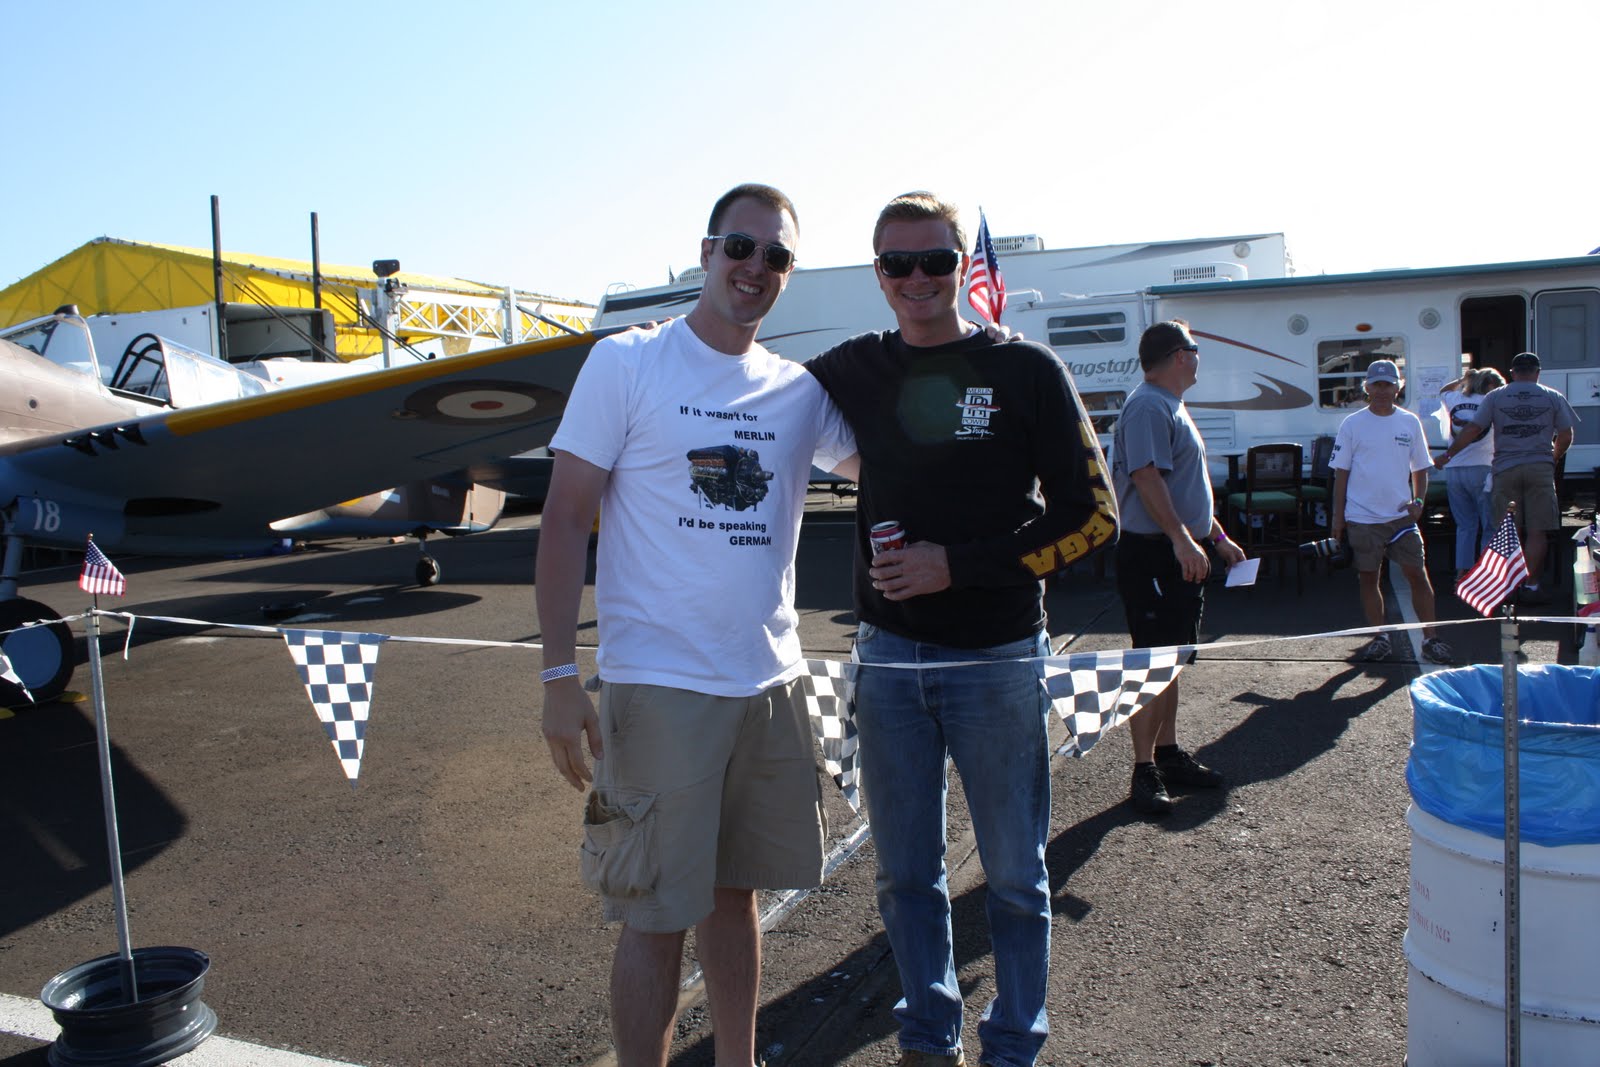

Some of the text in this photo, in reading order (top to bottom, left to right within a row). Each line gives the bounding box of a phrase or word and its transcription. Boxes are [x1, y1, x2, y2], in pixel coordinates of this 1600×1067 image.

[1064, 358, 1141, 377] lagstaff
[680, 405, 758, 422] If it wasn't for
[962, 418, 988, 426] POWER
[734, 430, 776, 441] MERLIN
[32, 499, 61, 532] 18
[678, 517, 767, 533] I'd be speaking
[729, 536, 772, 546] GERMAN
